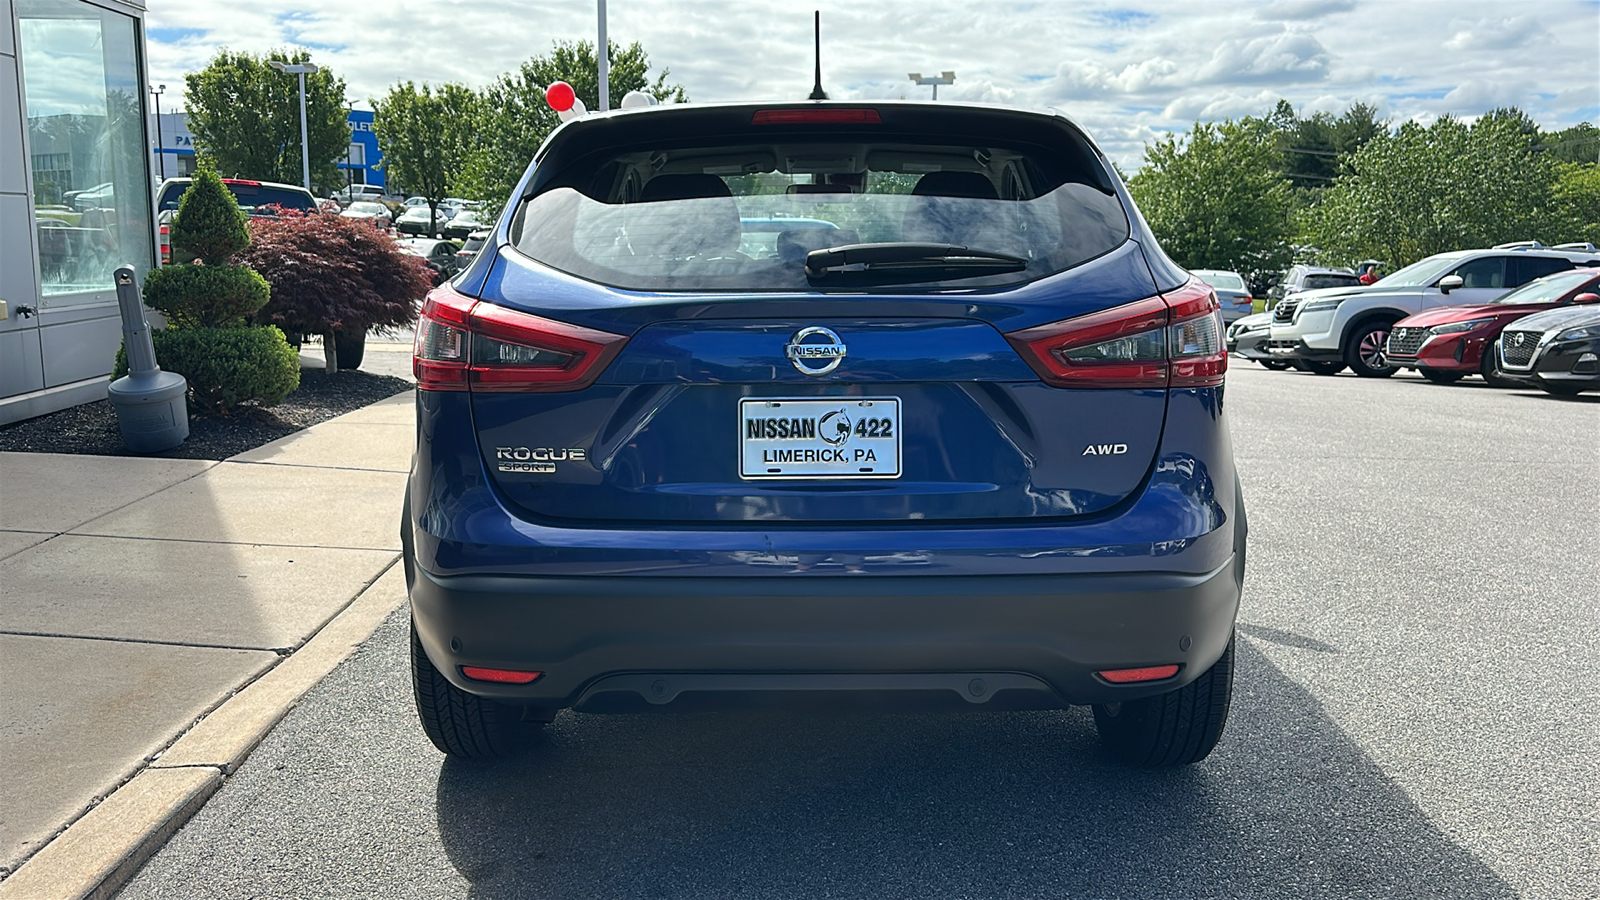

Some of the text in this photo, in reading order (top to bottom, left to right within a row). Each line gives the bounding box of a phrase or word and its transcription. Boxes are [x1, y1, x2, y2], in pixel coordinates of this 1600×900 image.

[793, 346, 840, 355] NISSAN
[747, 418, 893, 440] NISSAN 422
[496, 446, 586, 461] ROGUE
[763, 449, 877, 464] LIMERICK, PA
[1082, 443, 1128, 456] AWD
[503, 462, 549, 472] SPORT
